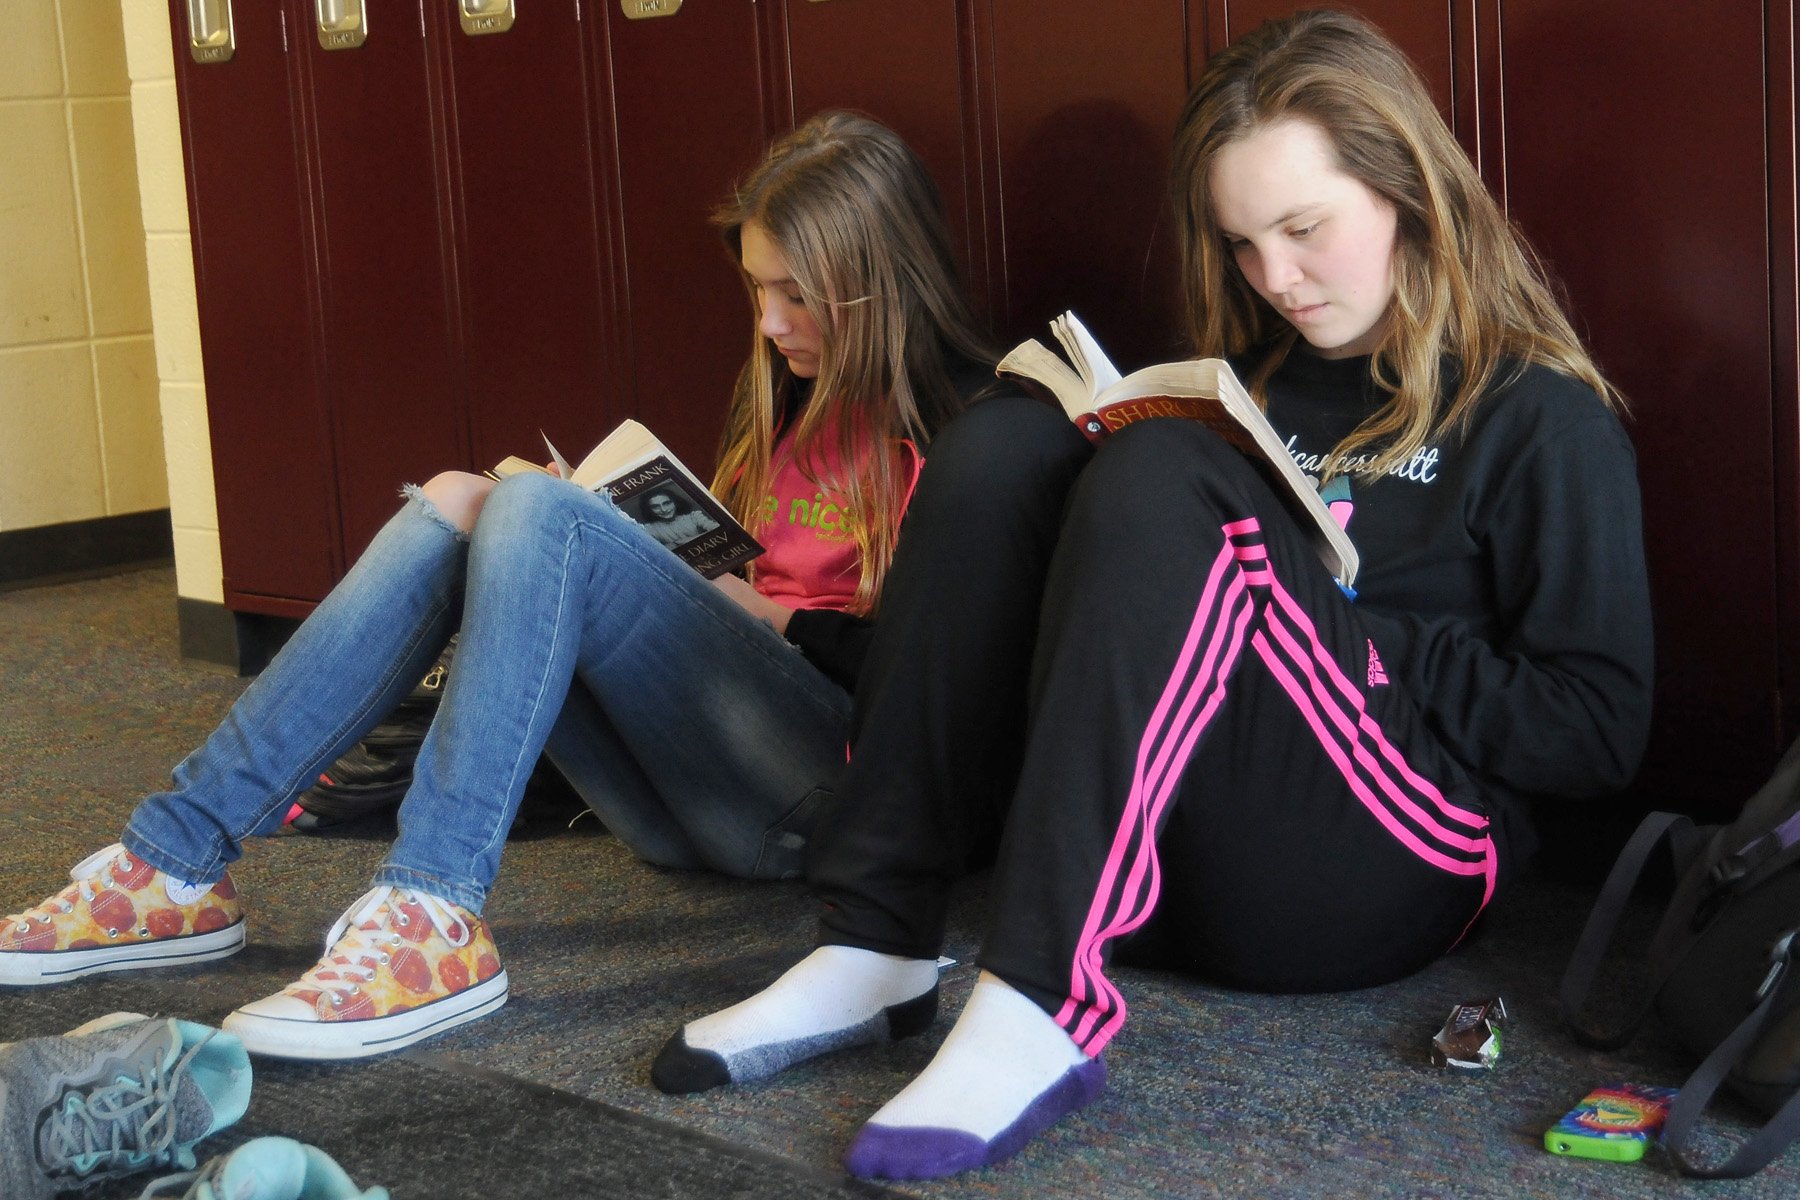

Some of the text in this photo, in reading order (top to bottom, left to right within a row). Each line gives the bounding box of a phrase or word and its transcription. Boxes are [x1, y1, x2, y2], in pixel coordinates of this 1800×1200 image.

[623, 463, 669, 490] FRANK
[763, 496, 779, 521] e
[688, 531, 728, 558] DIARY
[721, 542, 751, 561] GIRL
